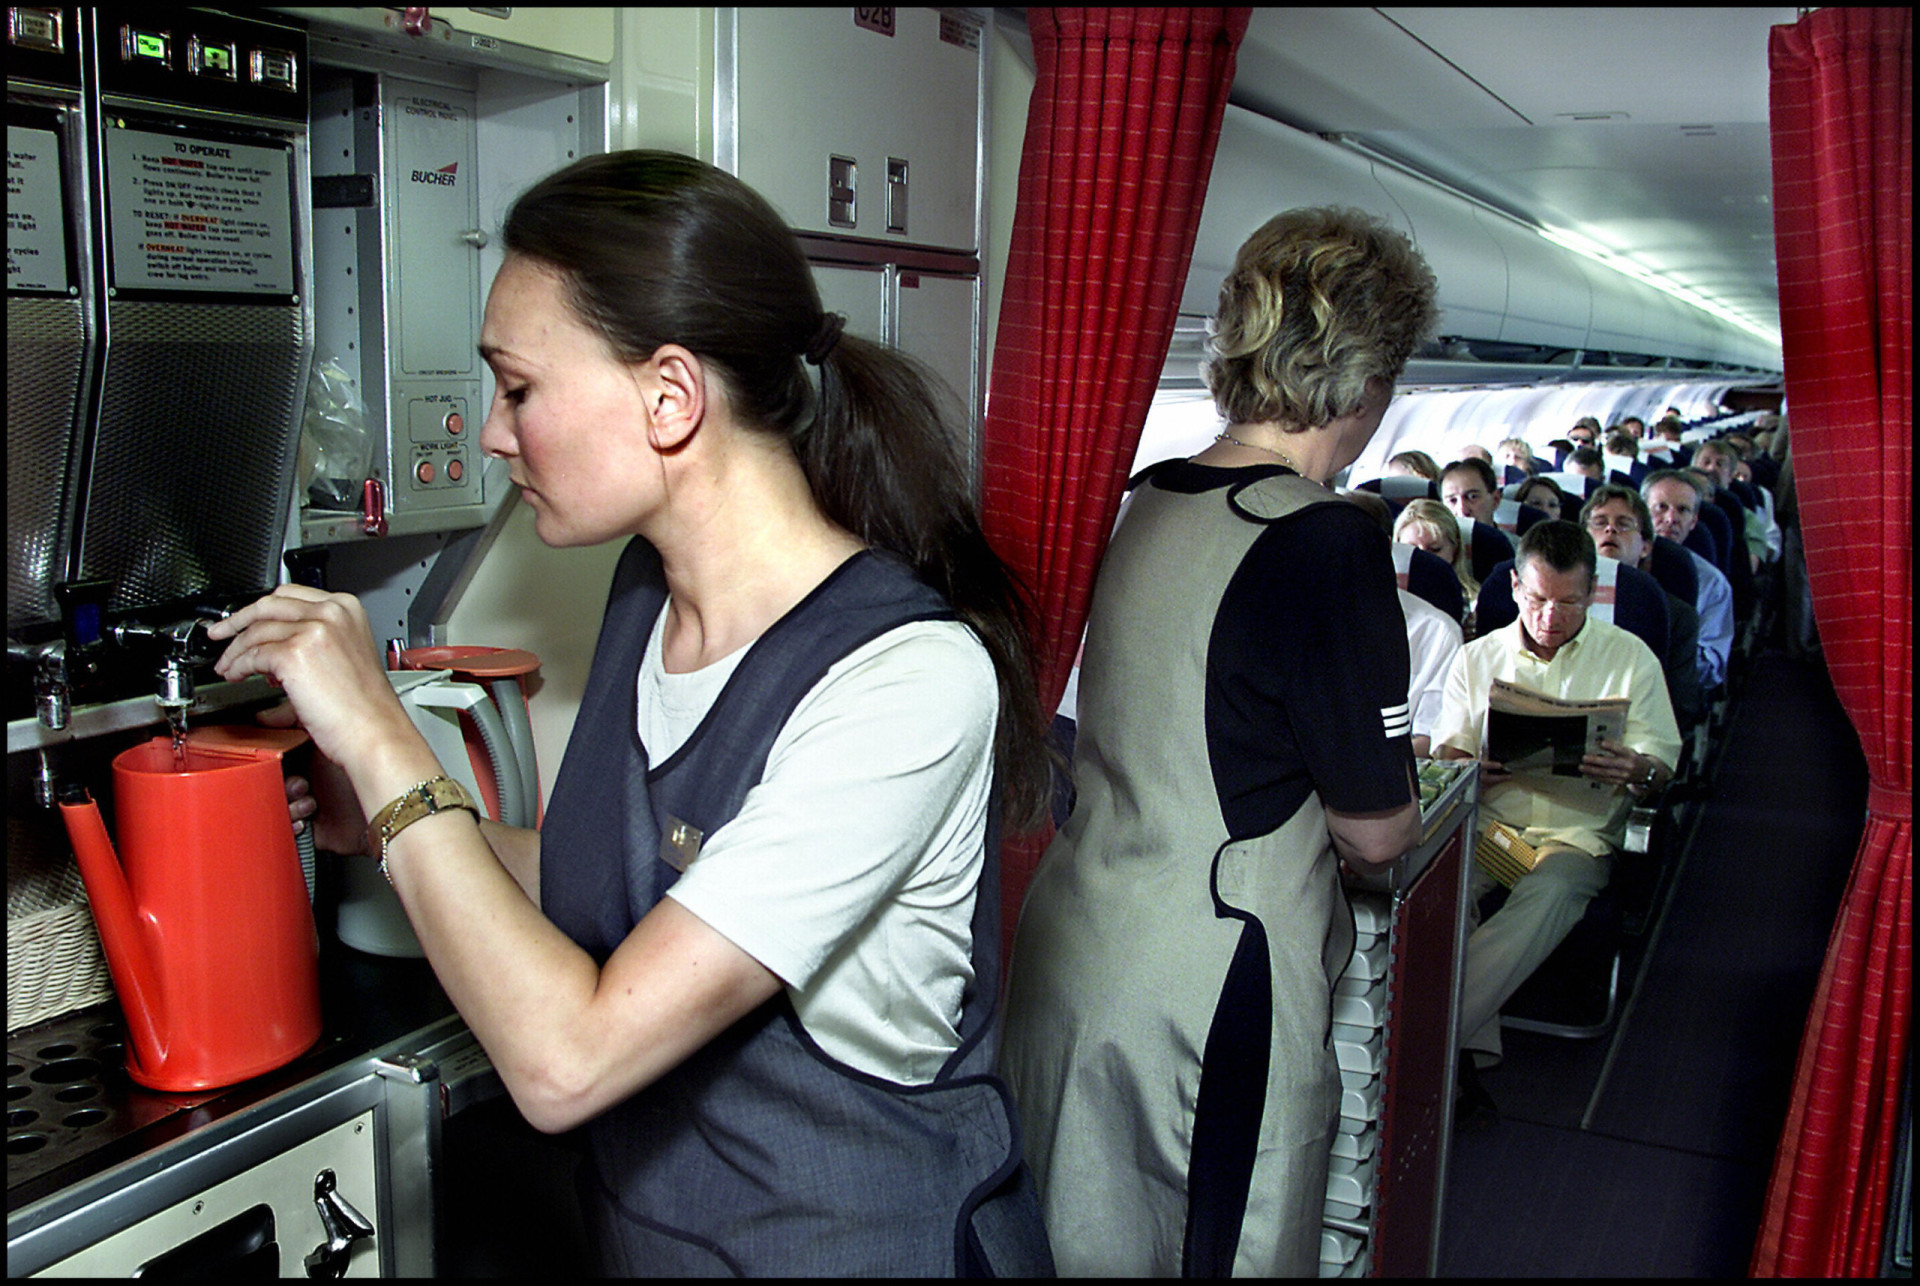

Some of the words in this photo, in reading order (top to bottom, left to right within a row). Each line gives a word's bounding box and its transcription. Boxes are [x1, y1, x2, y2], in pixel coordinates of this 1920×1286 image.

[405, 105, 437, 118] CONTROL
[174, 142, 186, 152] TO
[190, 145, 231, 159] OPERATE
[17, 177, 24, 185] it
[411, 170, 456, 186] BUCHER
[181, 214, 218, 224] OVERHEAT
[17, 221, 36, 231] light
[14, 247, 39, 255] cycles
[146, 243, 185, 252] OVERHEAT
[425, 395, 438, 403] HOT
[440, 441, 458, 449] LIGHT
